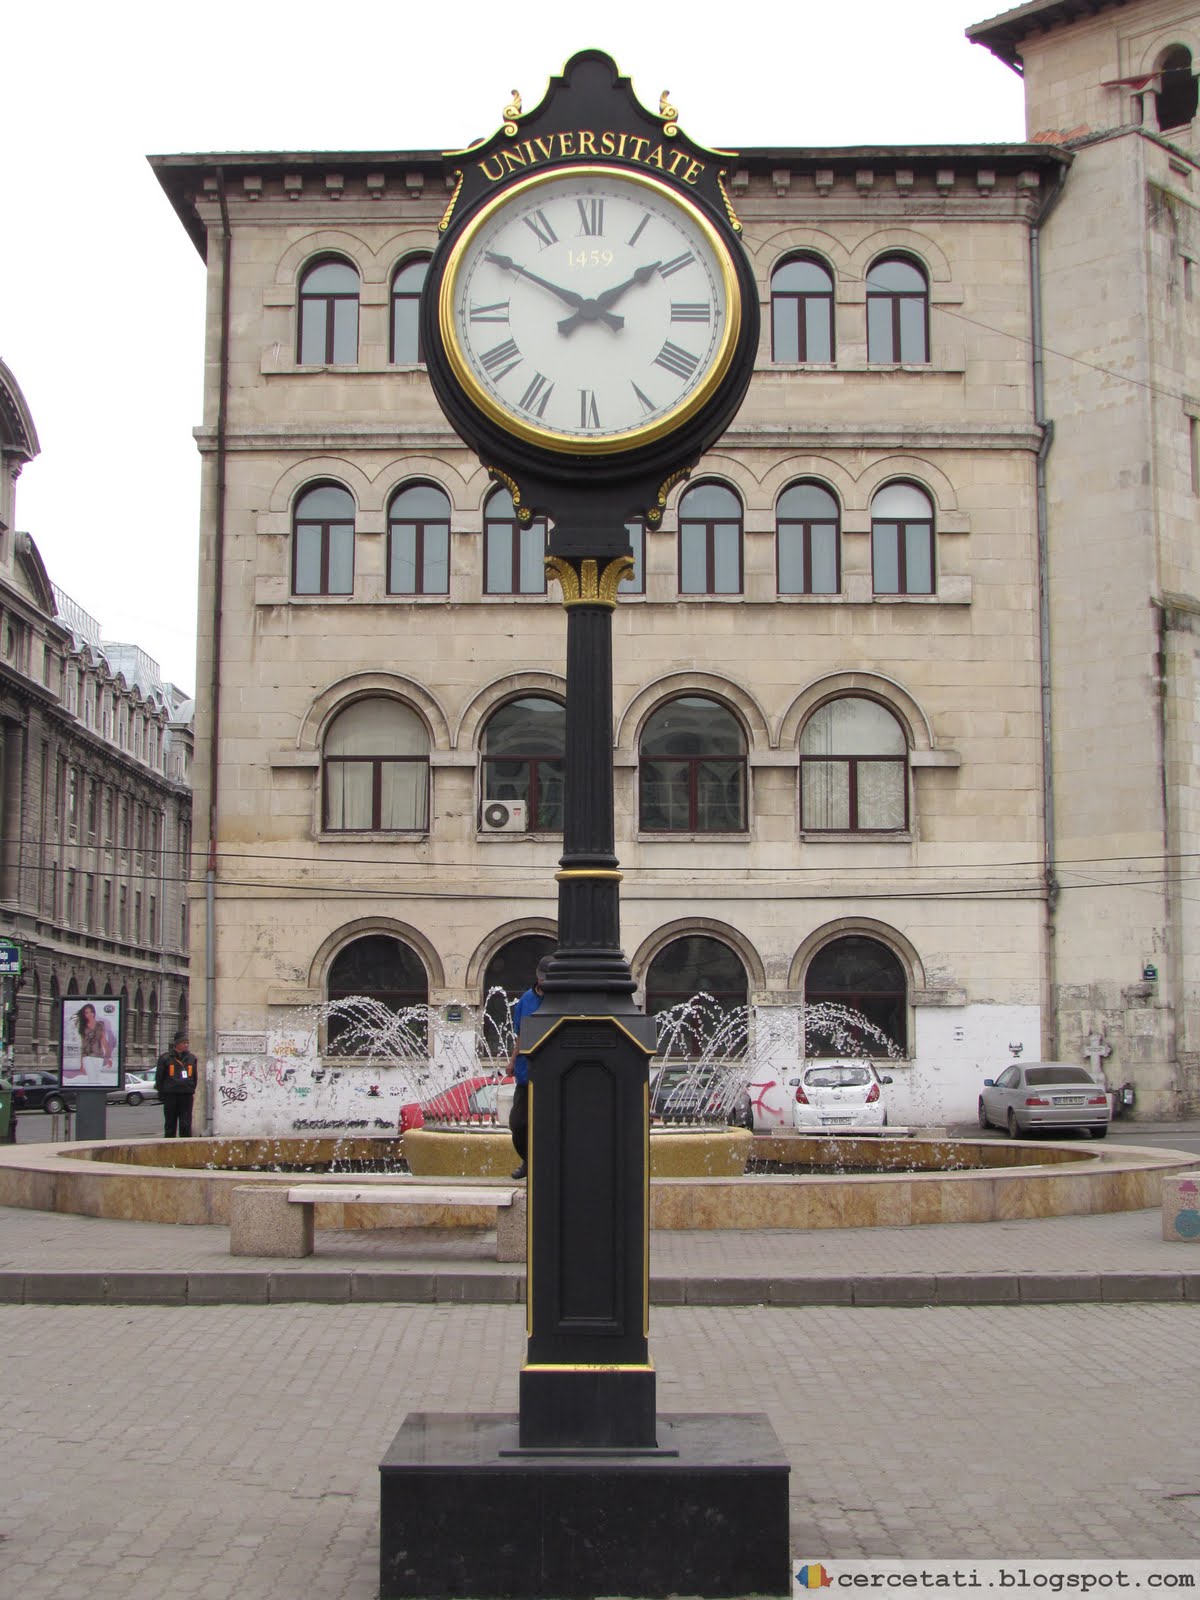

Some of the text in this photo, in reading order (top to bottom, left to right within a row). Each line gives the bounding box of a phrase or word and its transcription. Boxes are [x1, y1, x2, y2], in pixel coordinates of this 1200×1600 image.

[478, 131, 705, 185] UNIVERSITATE
[576, 199, 606, 237] XII
[567, 249, 614, 267] 1459
[669, 298, 710, 328] III
